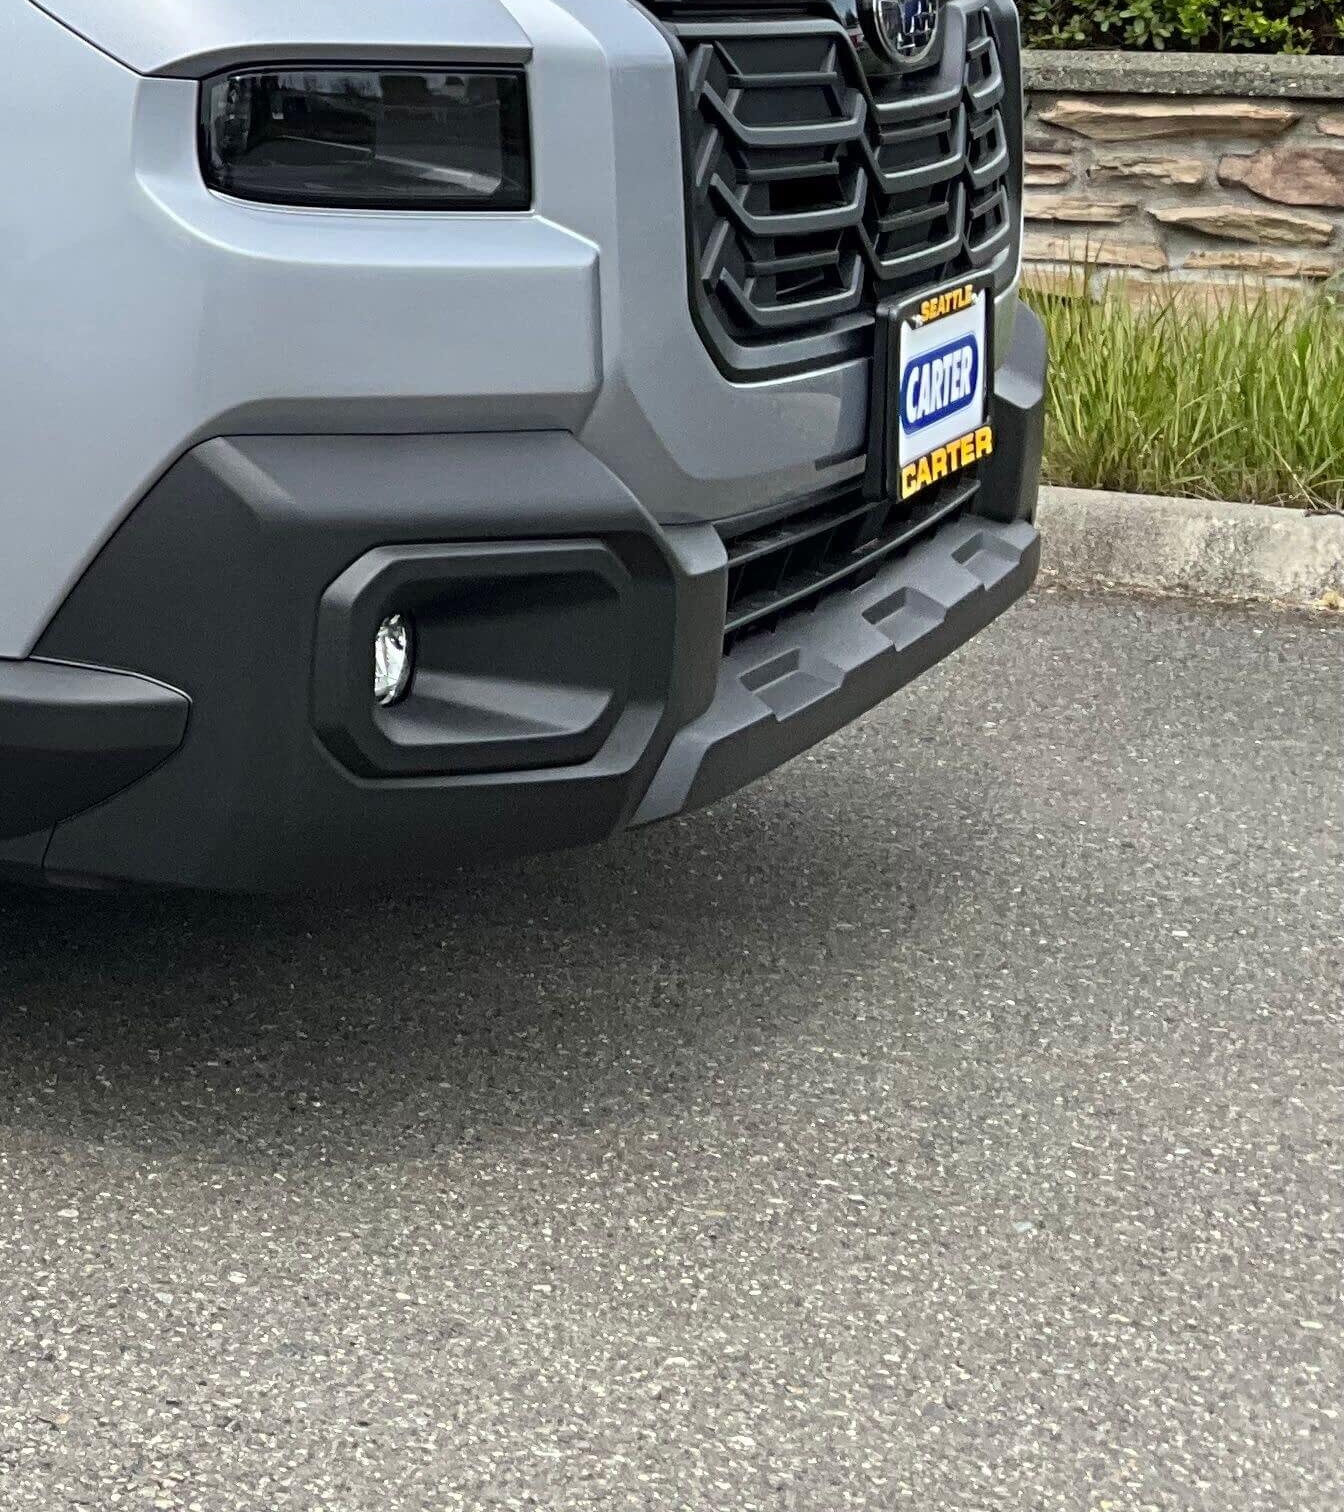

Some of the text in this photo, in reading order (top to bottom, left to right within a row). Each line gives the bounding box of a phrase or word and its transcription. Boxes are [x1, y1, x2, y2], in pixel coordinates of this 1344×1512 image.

[920, 284, 974, 323] SEATTLE
[906, 345, 973, 424] CARTER
[901, 425, 993, 500] CARTER
